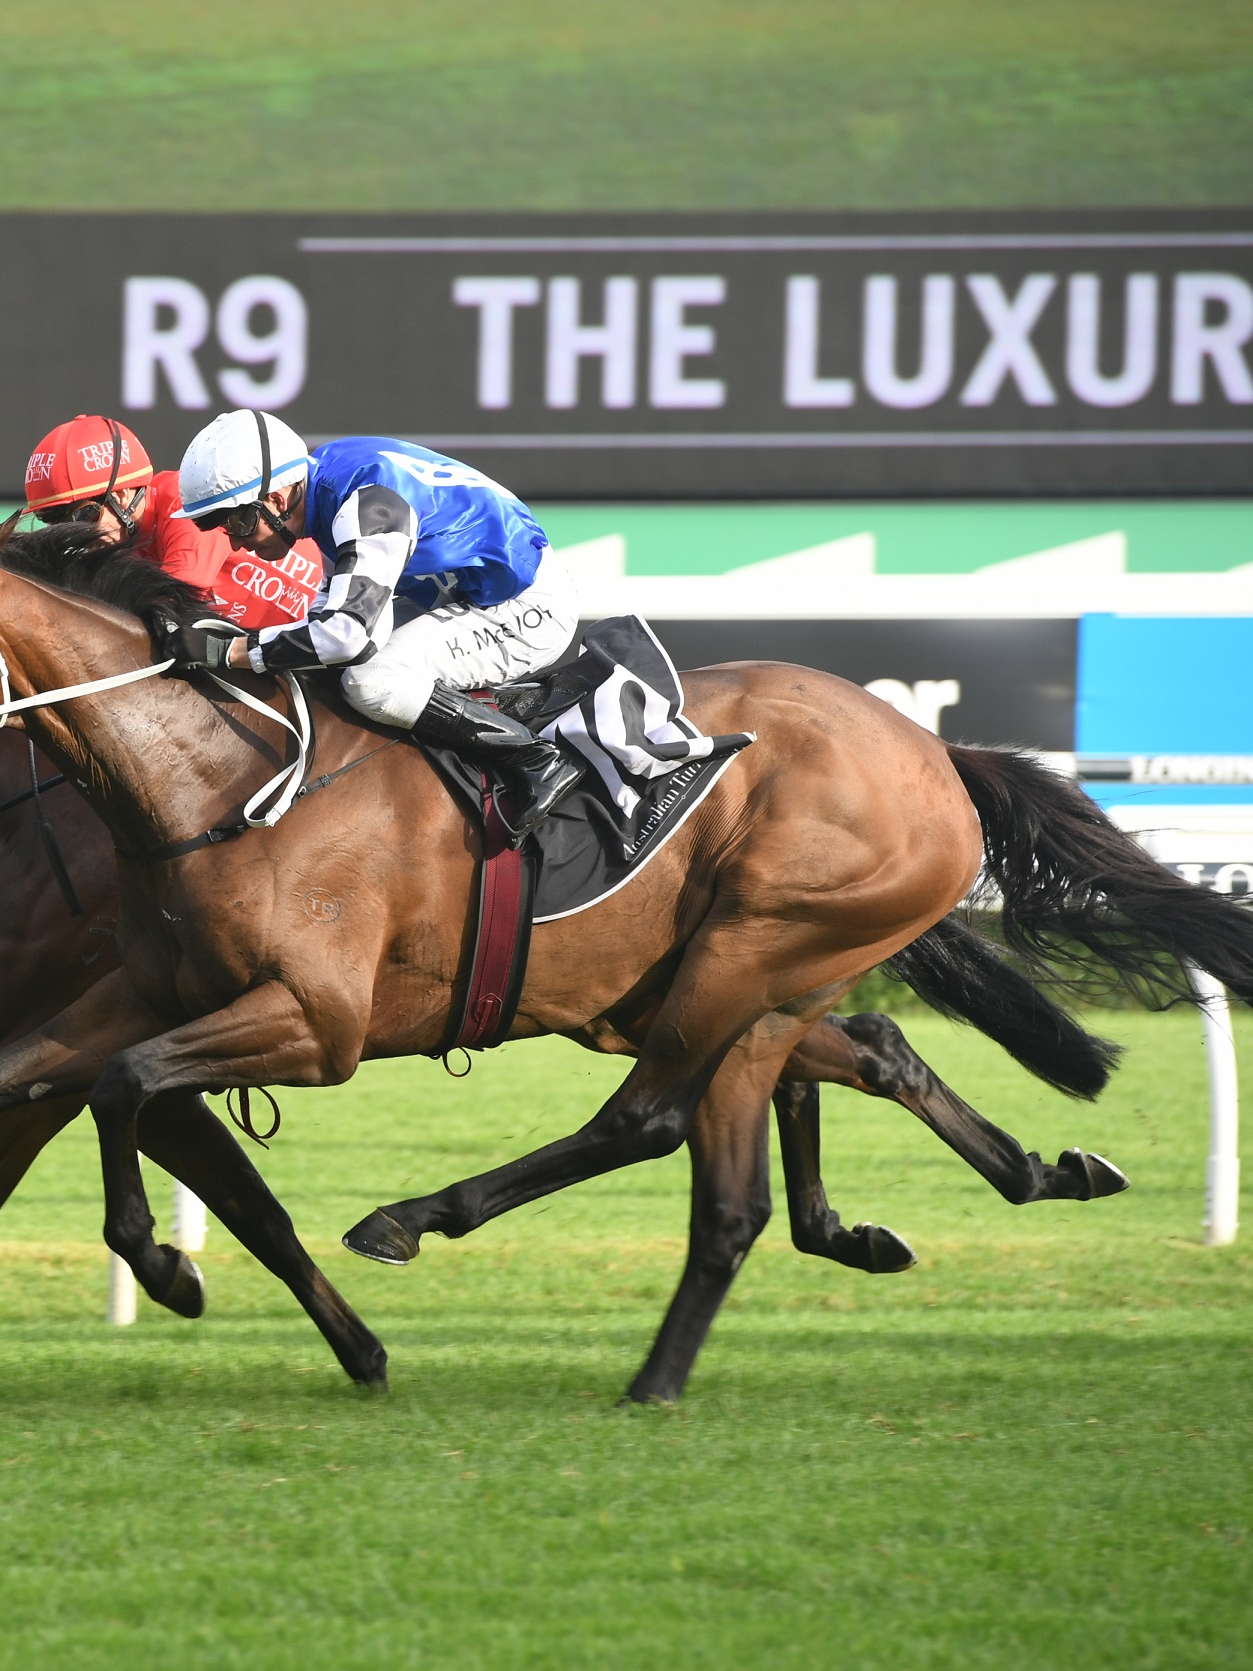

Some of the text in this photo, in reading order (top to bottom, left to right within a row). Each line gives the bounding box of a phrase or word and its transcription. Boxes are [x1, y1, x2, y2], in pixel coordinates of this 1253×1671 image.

[122, 272, 1253, 410] R9 THE LUXUR
[78, 440, 128, 460] TRIPE
[84, 450, 131, 472] CRON
